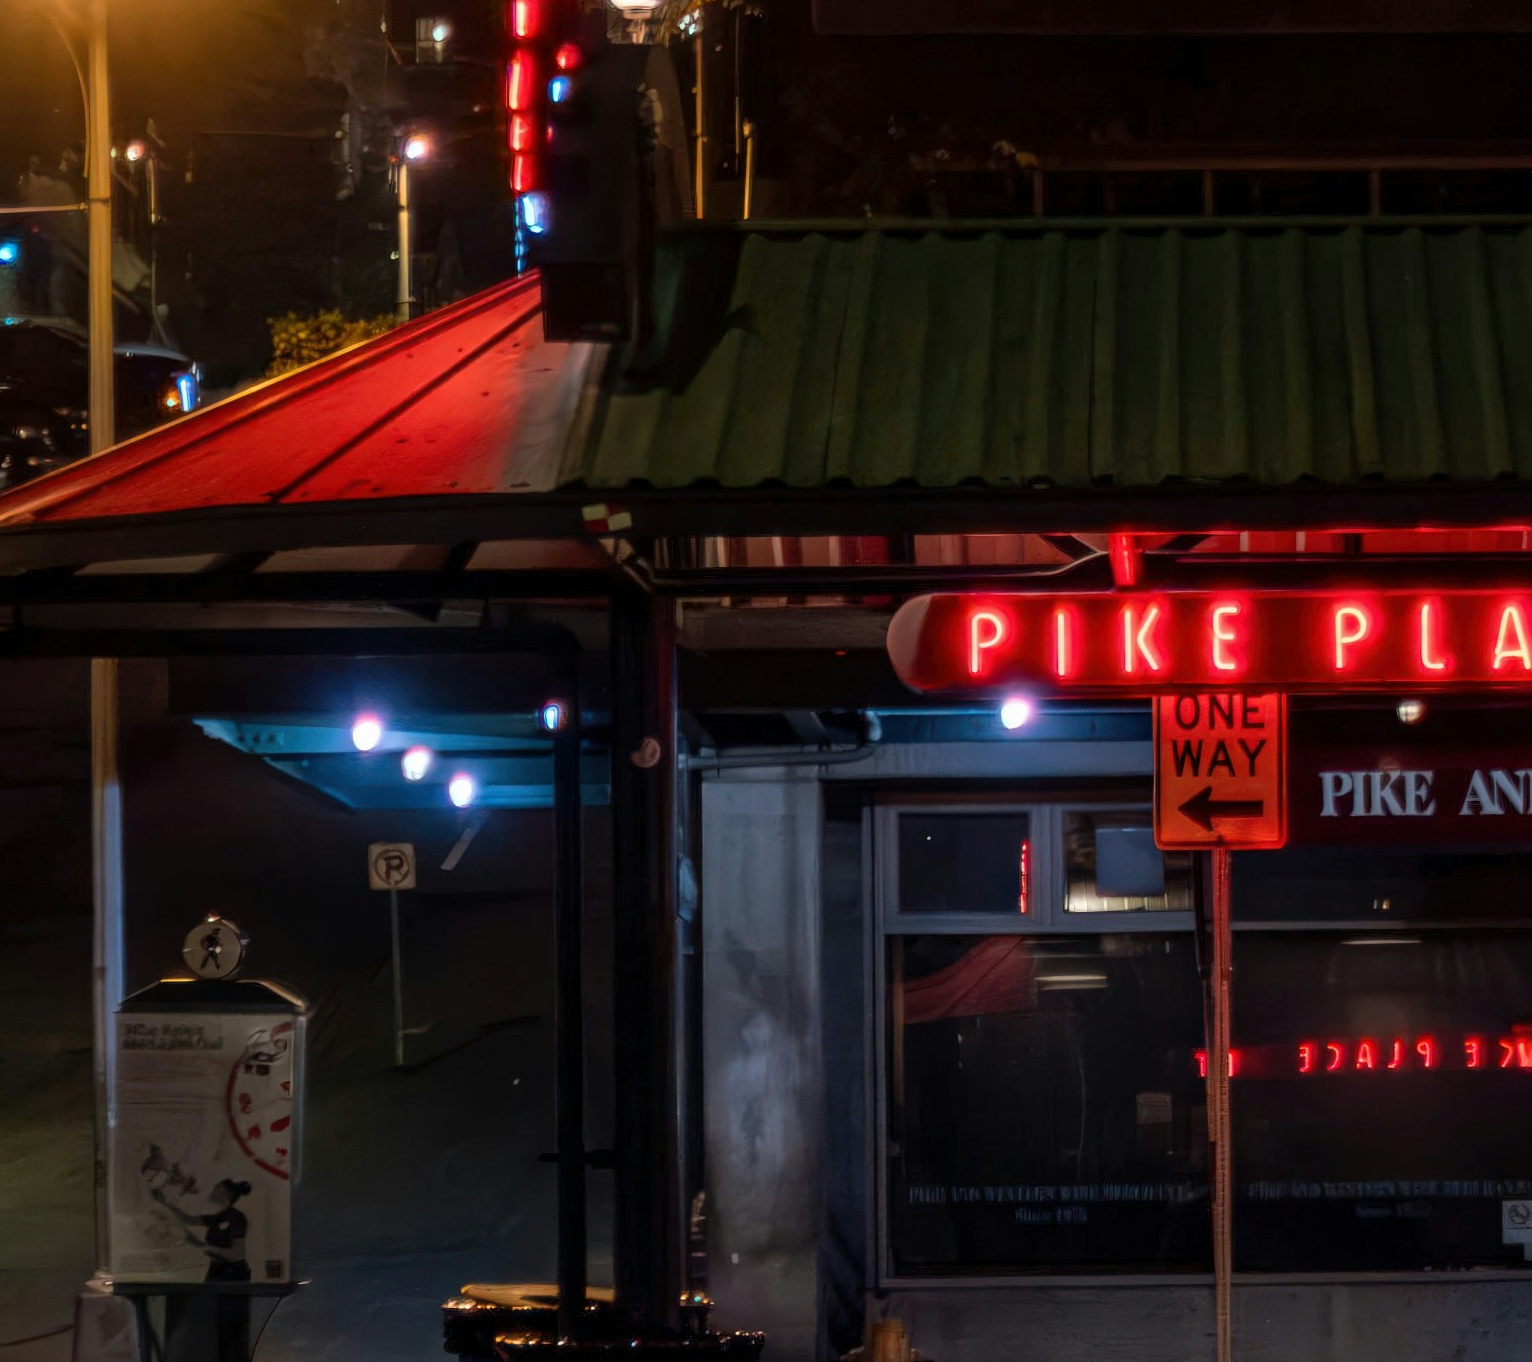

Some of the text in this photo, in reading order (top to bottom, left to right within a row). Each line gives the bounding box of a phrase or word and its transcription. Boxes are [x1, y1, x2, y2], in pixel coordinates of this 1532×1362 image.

[969, 604, 1242, 676] PIKE
[1175, 693, 1265, 730] ONE
[1172, 739, 1268, 778] WAY
[1318, 769, 1436, 817] PIKE
